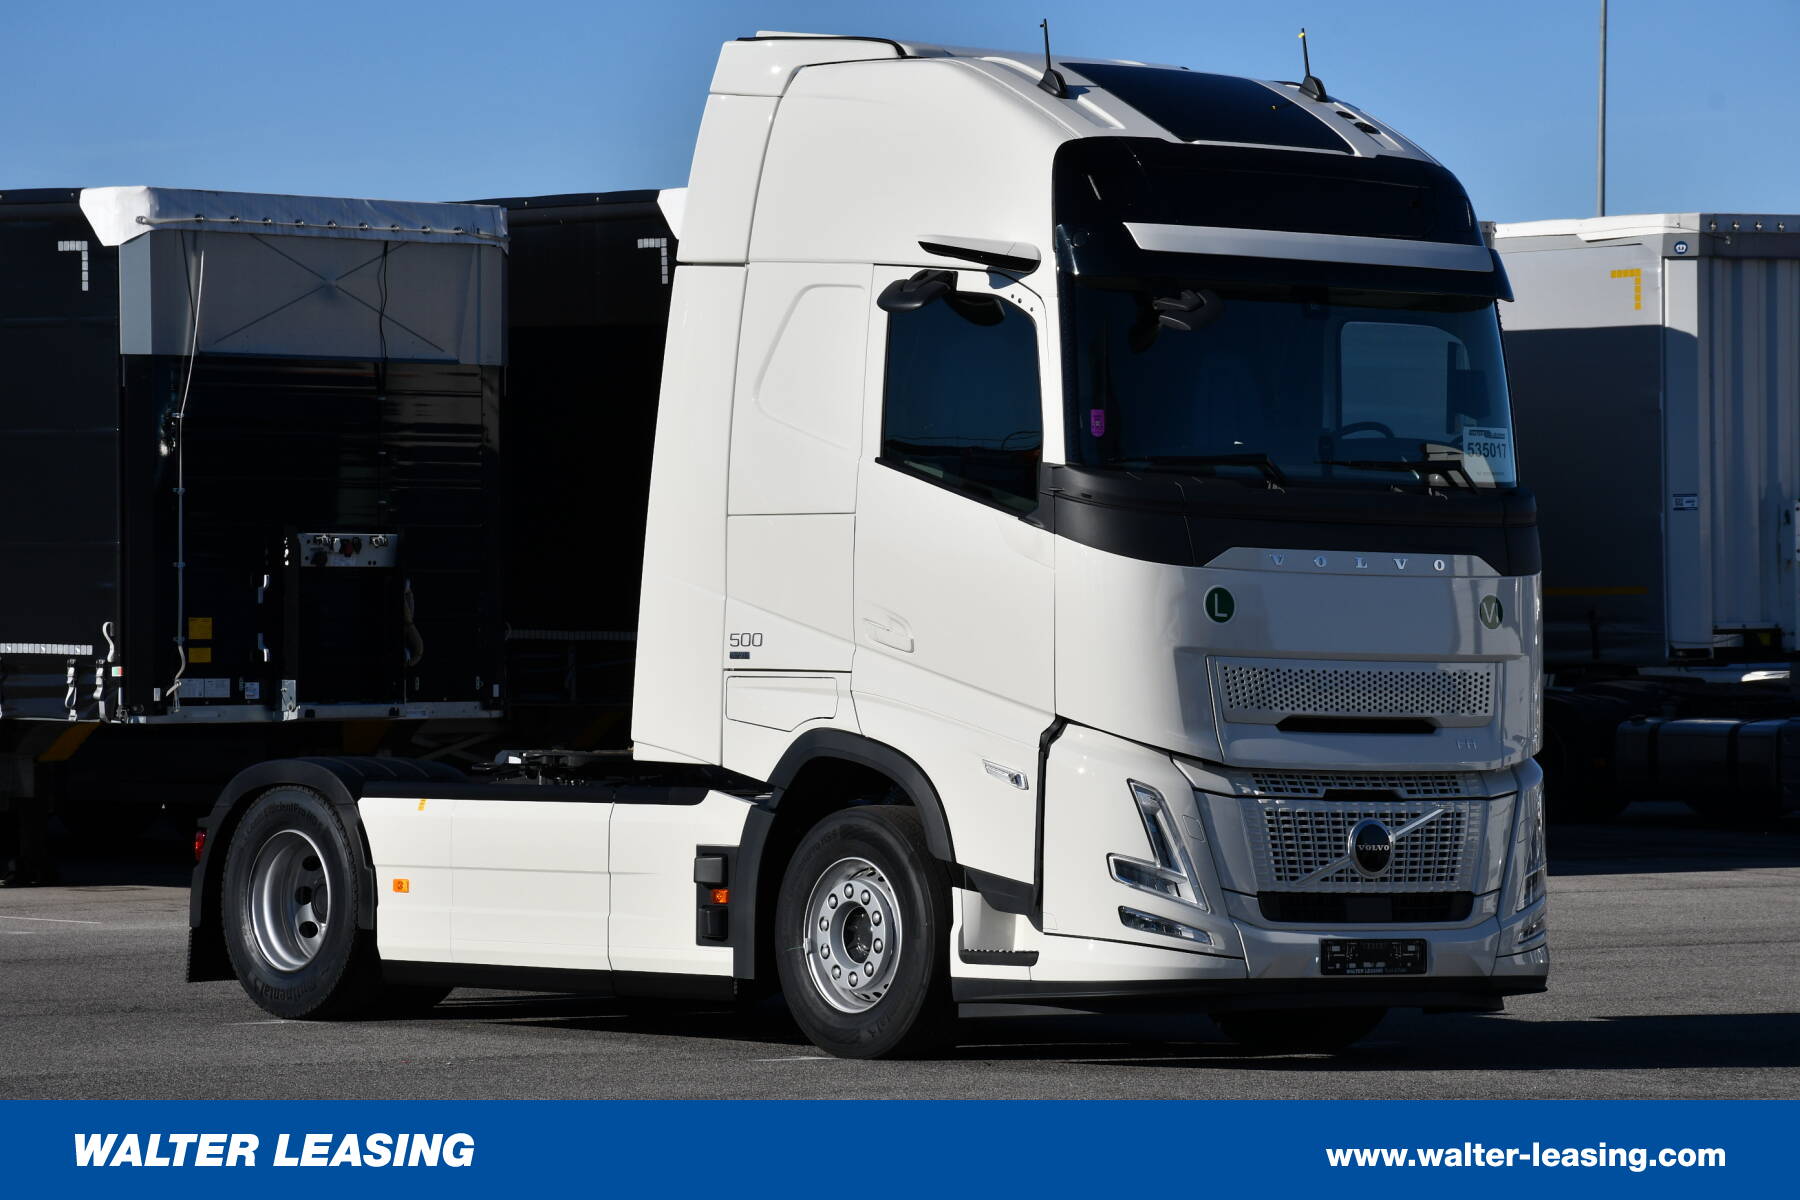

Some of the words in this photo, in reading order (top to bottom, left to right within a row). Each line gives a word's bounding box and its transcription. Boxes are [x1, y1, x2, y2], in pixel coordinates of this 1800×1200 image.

[1467, 442, 1507, 459] 535017
[1269, 553, 1445, 571] VOLVO
[729, 632, 763, 648] 500
[1358, 844, 1390, 852] VOLVO
